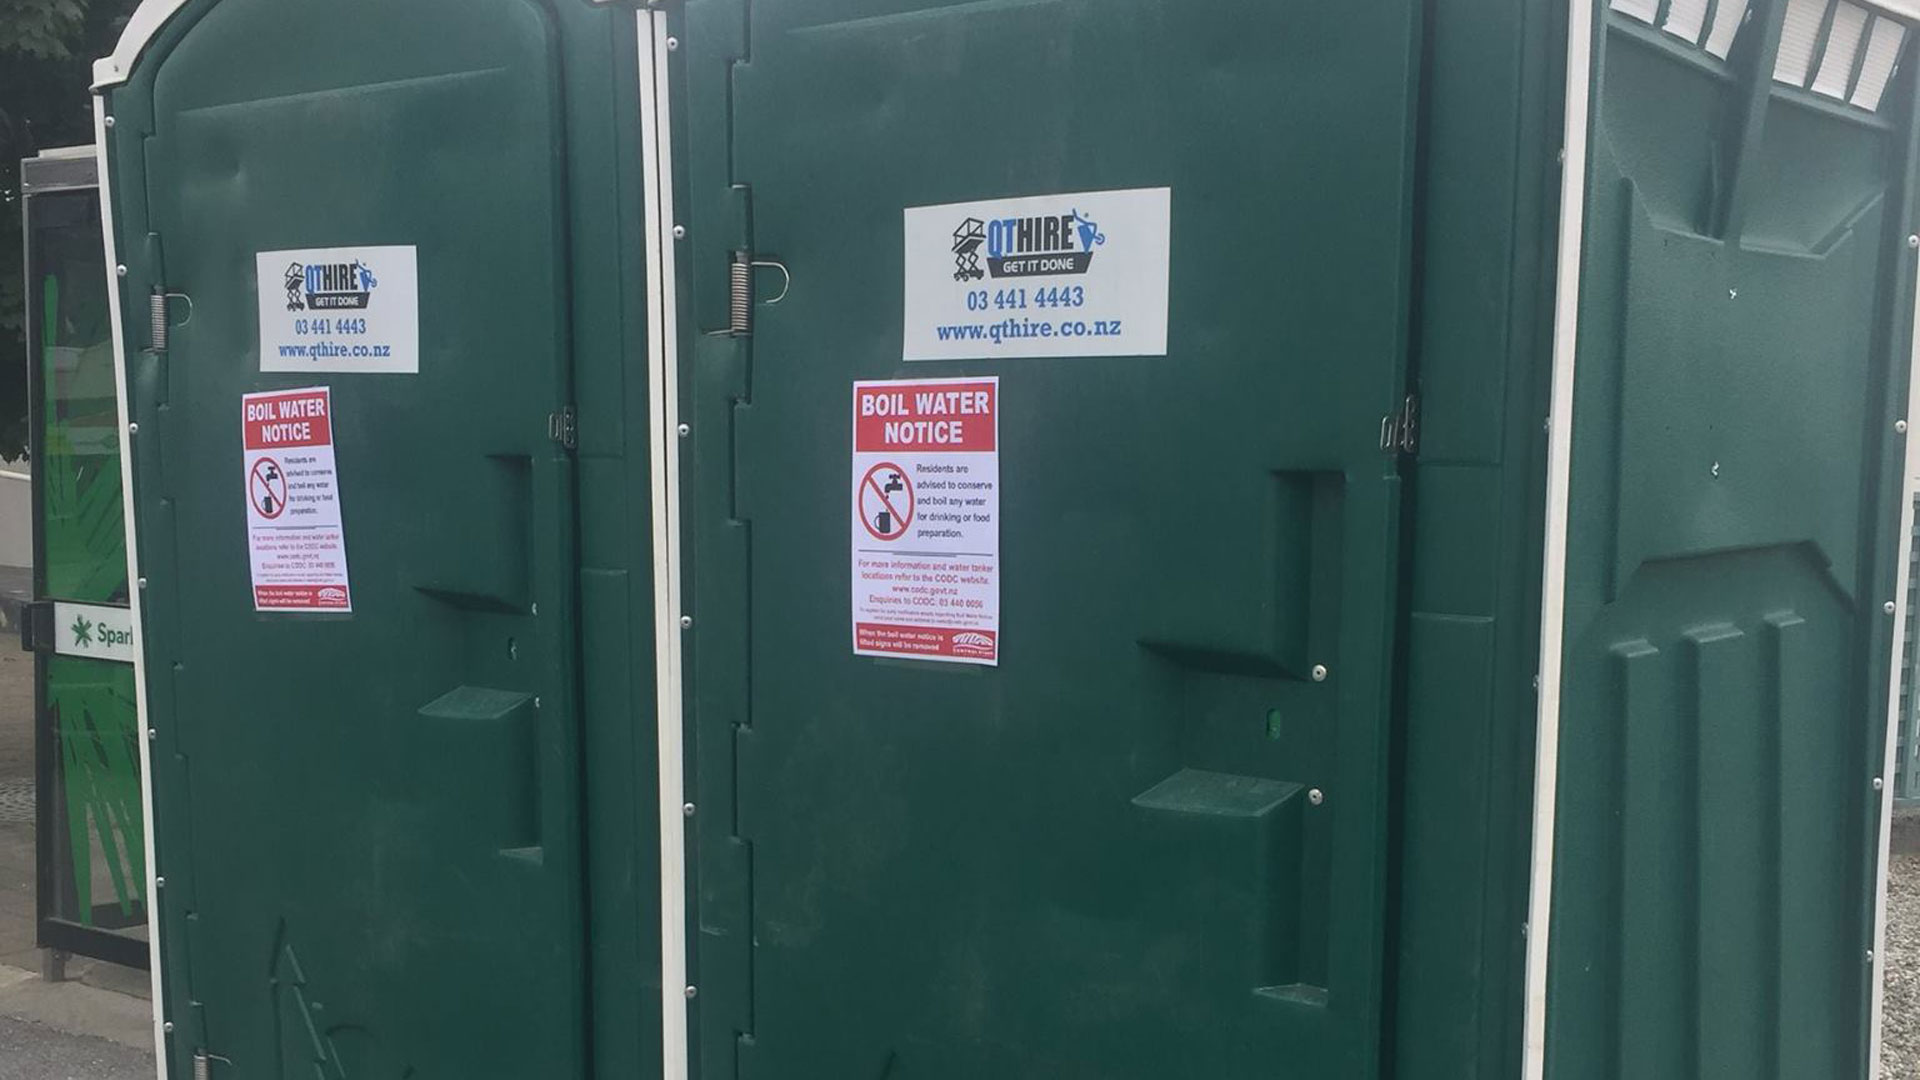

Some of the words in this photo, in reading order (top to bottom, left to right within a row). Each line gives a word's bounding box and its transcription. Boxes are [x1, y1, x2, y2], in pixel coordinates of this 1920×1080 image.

[987, 215, 1075, 258] QTHIRE
[1003, 261, 1026, 273] GET
[1028, 260, 1039, 272] IT
[1040, 258, 1074, 271] DONE
[306, 263, 358, 294] QTHIRE
[315, 297, 328, 307] GET
[329, 297, 338, 306] IT
[338, 296, 359, 307] DONE
[968, 291, 988, 311] 03
[994, 289, 1027, 309] 441
[1034, 286, 1084, 307] 4443
[295, 319, 308, 335] 03
[311, 319, 331, 334] 441
[336, 318, 366, 334] 4443
[937, 317, 1121, 344] www.qthire.co.nz
[279, 341, 390, 361] www.qthire.co.nz
[247, 402, 276, 422] BOIL
[279, 398, 325, 419] WATER
[862, 393, 909, 416] BOIL
[916, 391, 989, 415] WATER
[262, 422, 311, 443] NOTICE
[885, 421, 963, 444] NOTICE
[916, 464, 954, 473] Residents
[956, 465, 969, 473] are
[916, 481, 949, 490] advised
[950, 481, 957, 490] to
[958, 482, 993, 490] conserve
[917, 497, 930, 505] and
[932, 497, 948, 505] boil
[950, 498, 963, 508] any
[965, 498, 987, 506] water
[917, 513, 927, 521] for
[929, 513, 961, 524] drinking
[963, 514, 972, 522] or
[973, 514, 991, 522] food
[917, 529, 963, 539] preparation.
